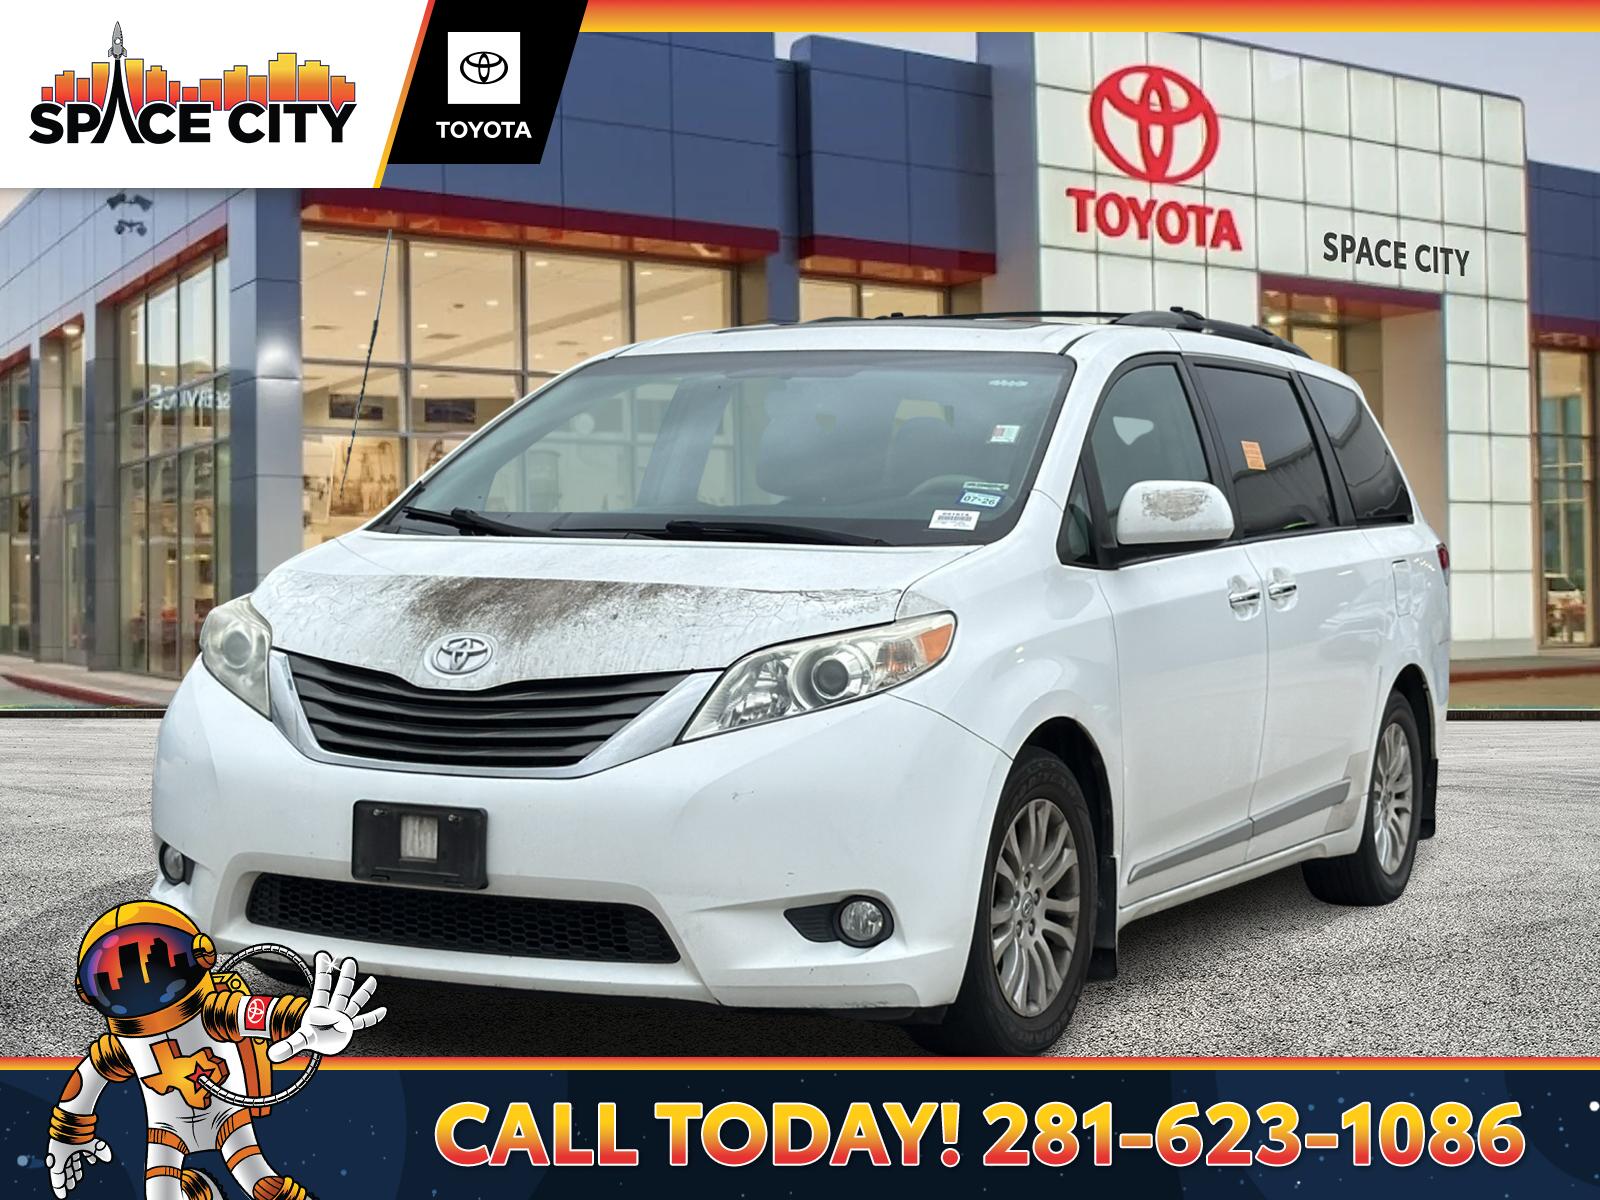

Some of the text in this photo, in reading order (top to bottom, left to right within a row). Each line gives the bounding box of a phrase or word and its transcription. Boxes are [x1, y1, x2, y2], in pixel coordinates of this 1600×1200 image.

[1066, 187, 1242, 252] TOYOTA
[1323, 232, 1470, 277] SPACE CITY
